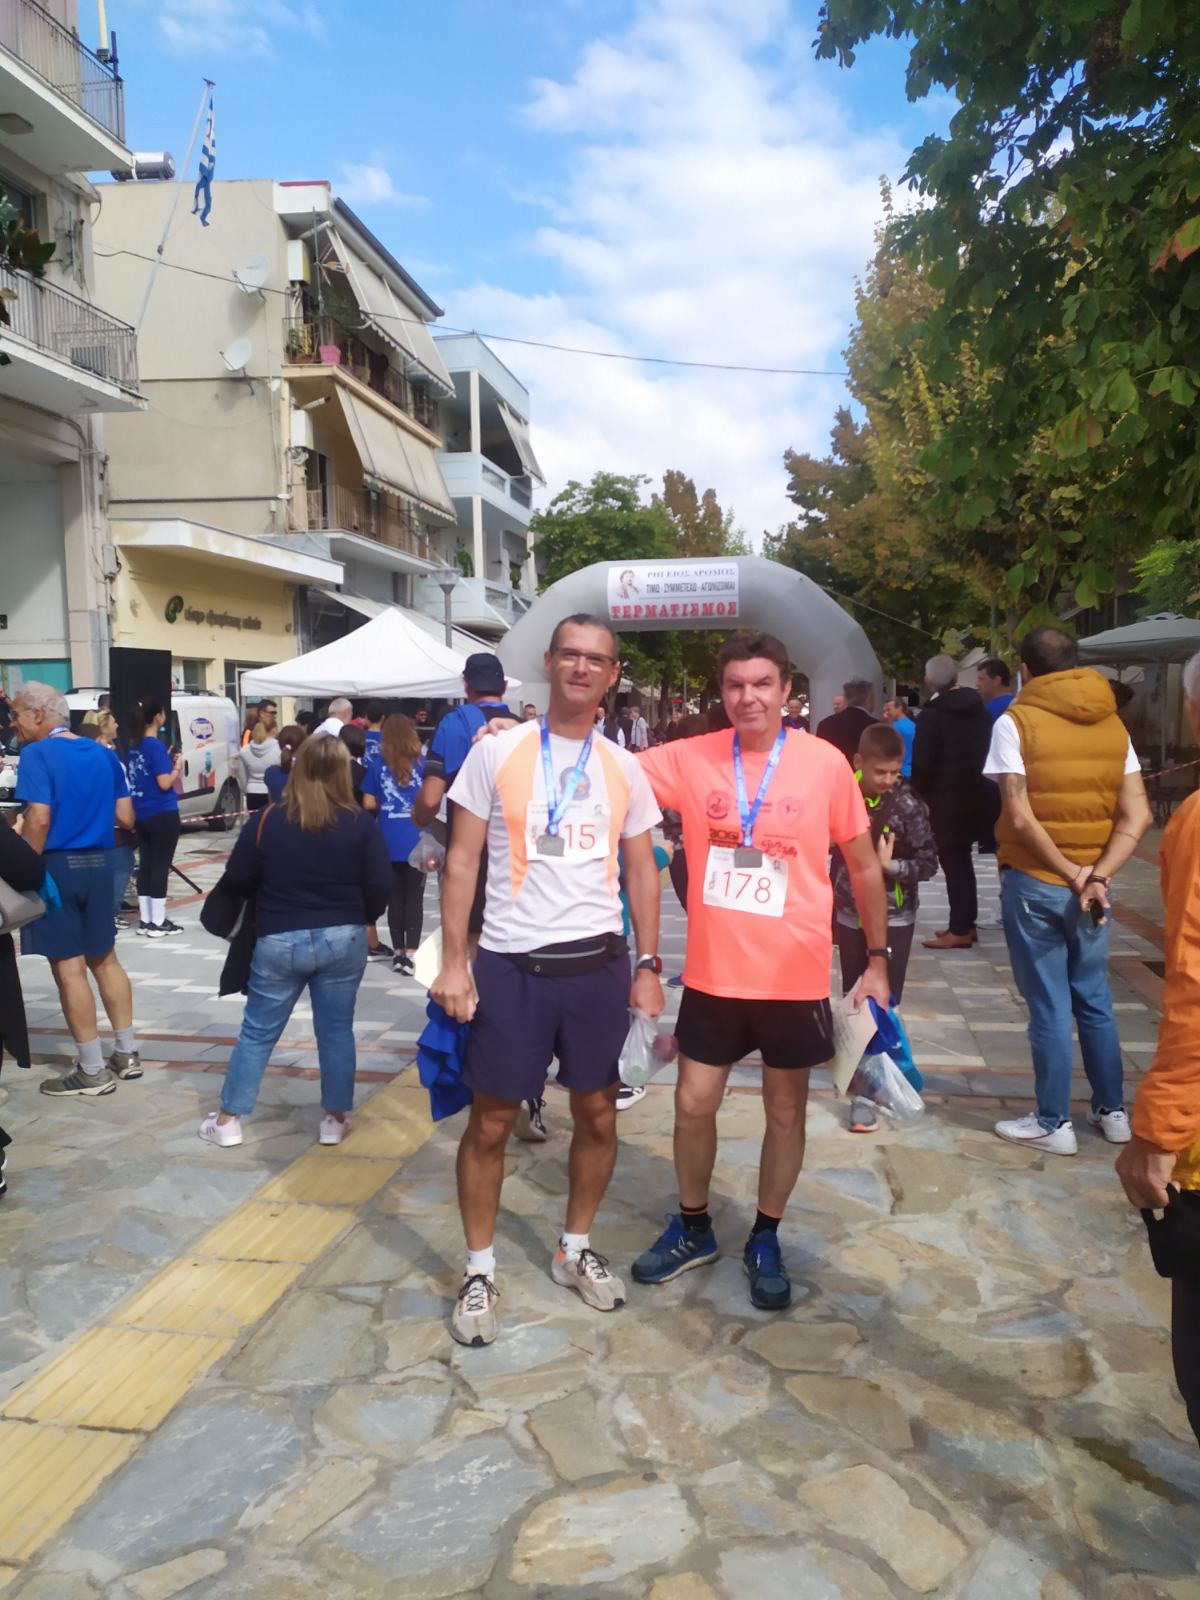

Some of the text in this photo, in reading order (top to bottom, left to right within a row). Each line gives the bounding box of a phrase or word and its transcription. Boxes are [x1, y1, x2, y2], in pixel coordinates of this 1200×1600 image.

[611, 602, 737, 619] ΤΕΡΜΑΤΙΣΜΟΣ
[544, 823, 596, 850] 15
[723, 871, 771, 904] 178
